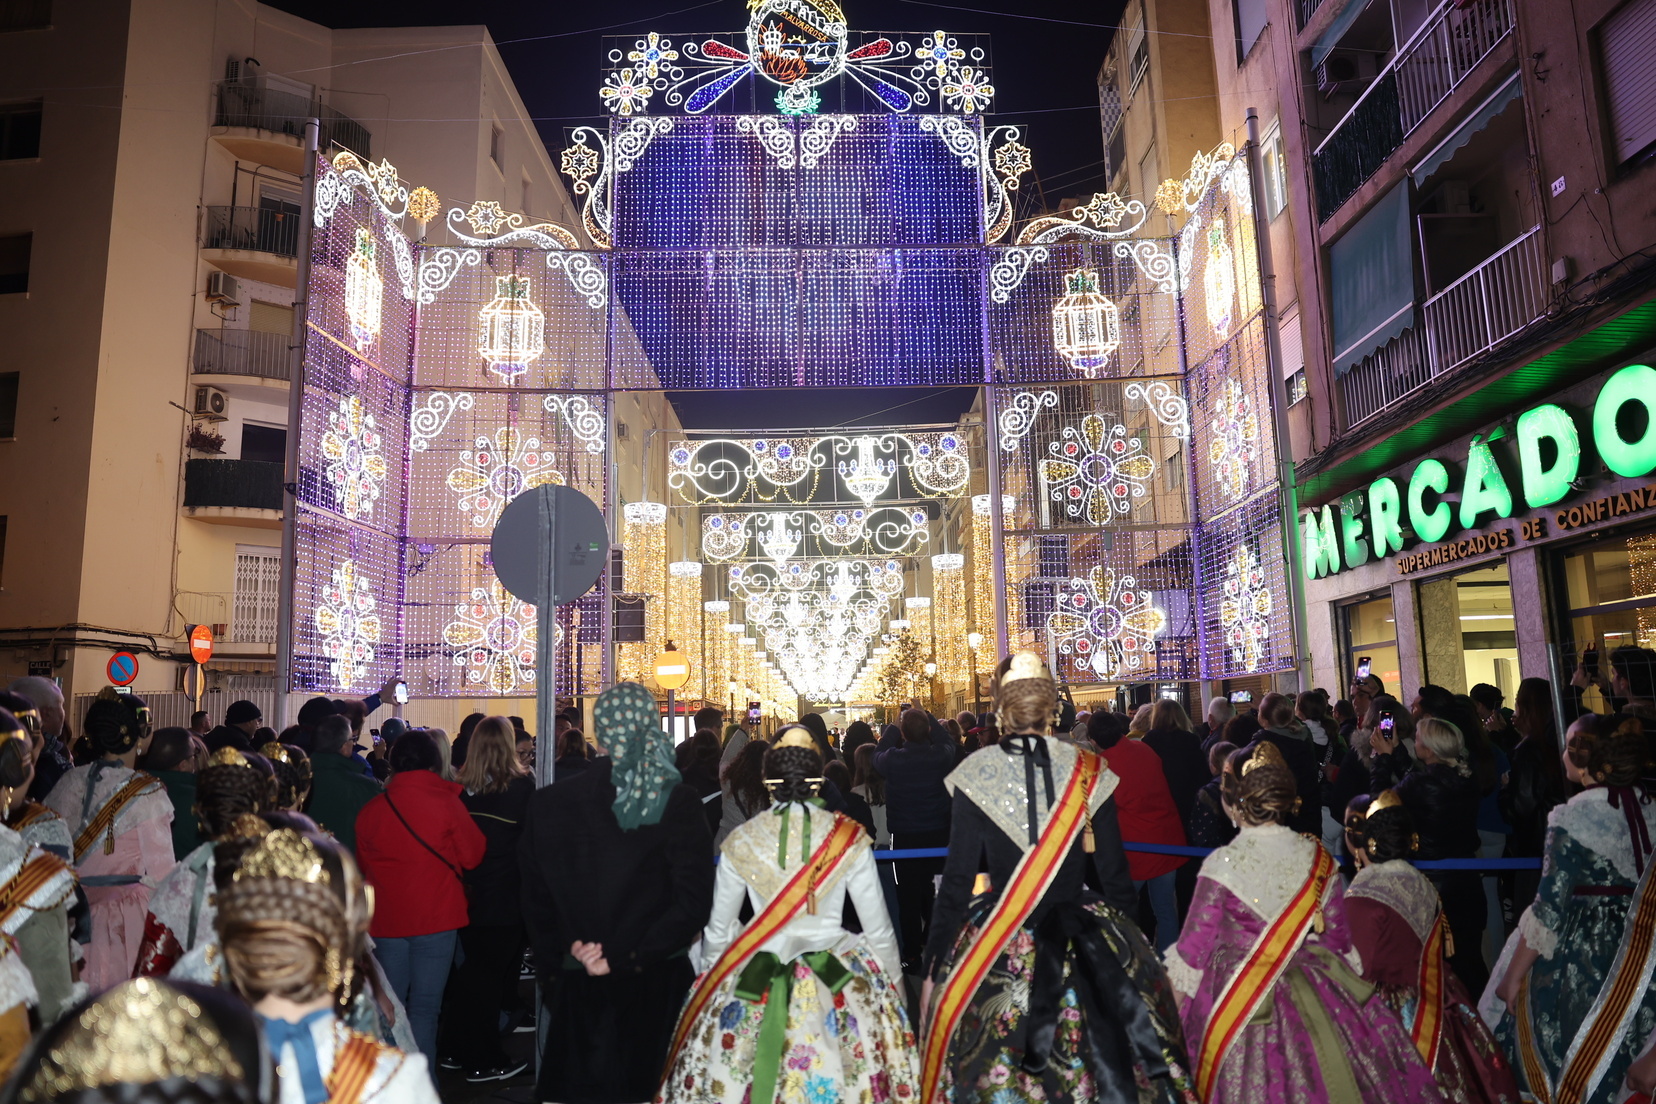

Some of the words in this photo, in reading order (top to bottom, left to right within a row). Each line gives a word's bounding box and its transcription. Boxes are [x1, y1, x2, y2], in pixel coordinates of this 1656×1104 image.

[780, 10, 828, 42] MALVARROSA
[790, 1, 832, 36] FALLA
[1397, 529, 1510, 575] SUPERMERCADOS
[1521, 518, 1542, 541] DE
